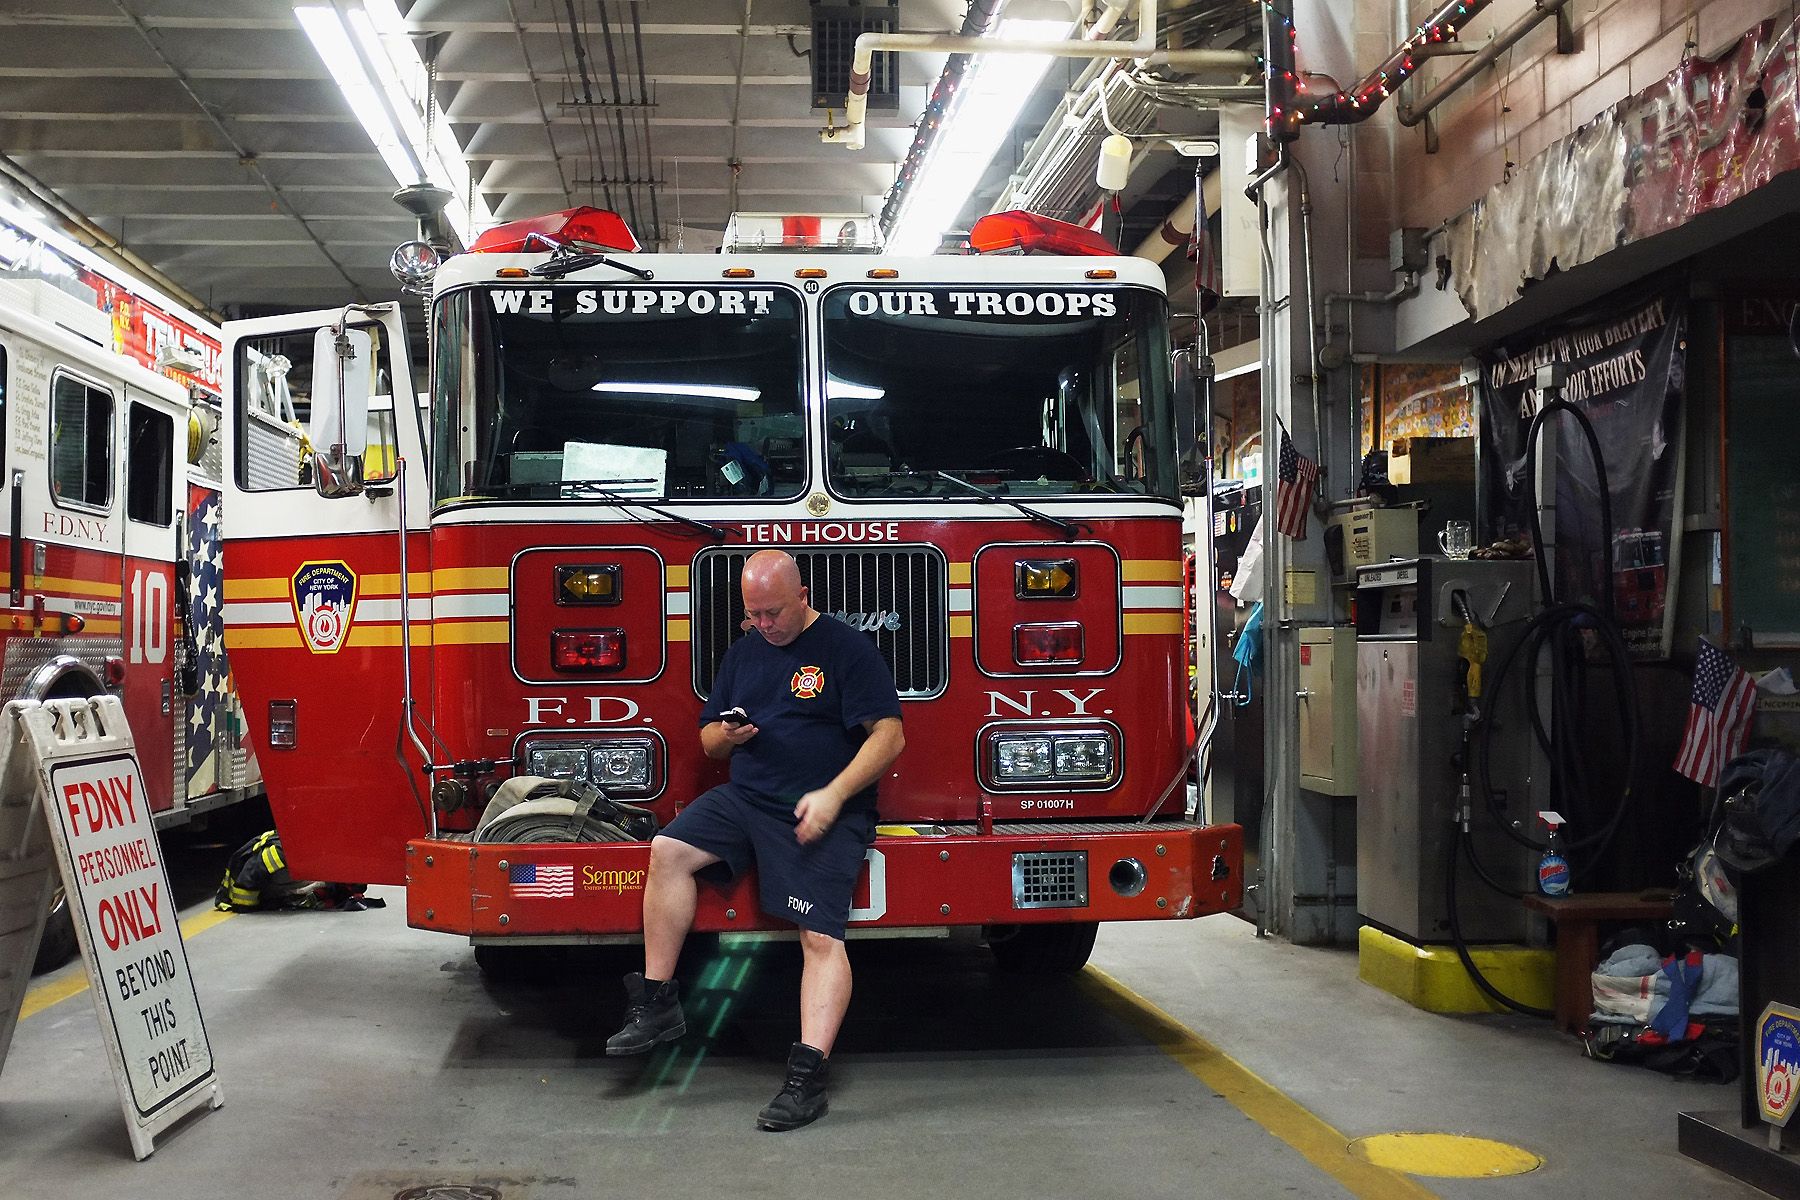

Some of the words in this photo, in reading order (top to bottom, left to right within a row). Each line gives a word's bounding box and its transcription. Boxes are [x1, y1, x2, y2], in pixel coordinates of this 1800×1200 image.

[490, 290, 553, 314] WE
[576, 290, 774, 315] SUPPORT
[805, 282, 817, 292] 40
[848, 291, 939, 316] OUR
[949, 292, 1117, 317] TROOPS
[1491, 361, 1508, 390] IN
[1572, 329, 1603, 359] YOUR
[1521, 387, 1537, 419] AN
[1589, 349, 1646, 397] EFFORTS
[43, 512, 109, 543] F.D.N.Y.
[742, 524, 792, 542] TEN
[801, 522, 899, 542] HOUSE
[299, 572, 312, 586] FIRE
[311, 567, 349, 584] DEPARTMENT
[130, 569, 167, 664] 10
[521, 696, 653, 724] F.D.
[983, 688, 1113, 717] N.Y.
[62, 774, 138, 837] FDNY
[1020, 800, 1034, 810] SP
[1037, 800, 1074, 809] 01007H
[78, 837, 156, 887] PERSONNEL
[582, 865, 645, 896] Semper
[98, 883, 162, 952] ONLY
[788, 895, 813, 915] FDNY
[116, 949, 176, 1001] BEYOND
[141, 998, 177, 1041] THIS
[149, 1038, 191, 1090] POINT
